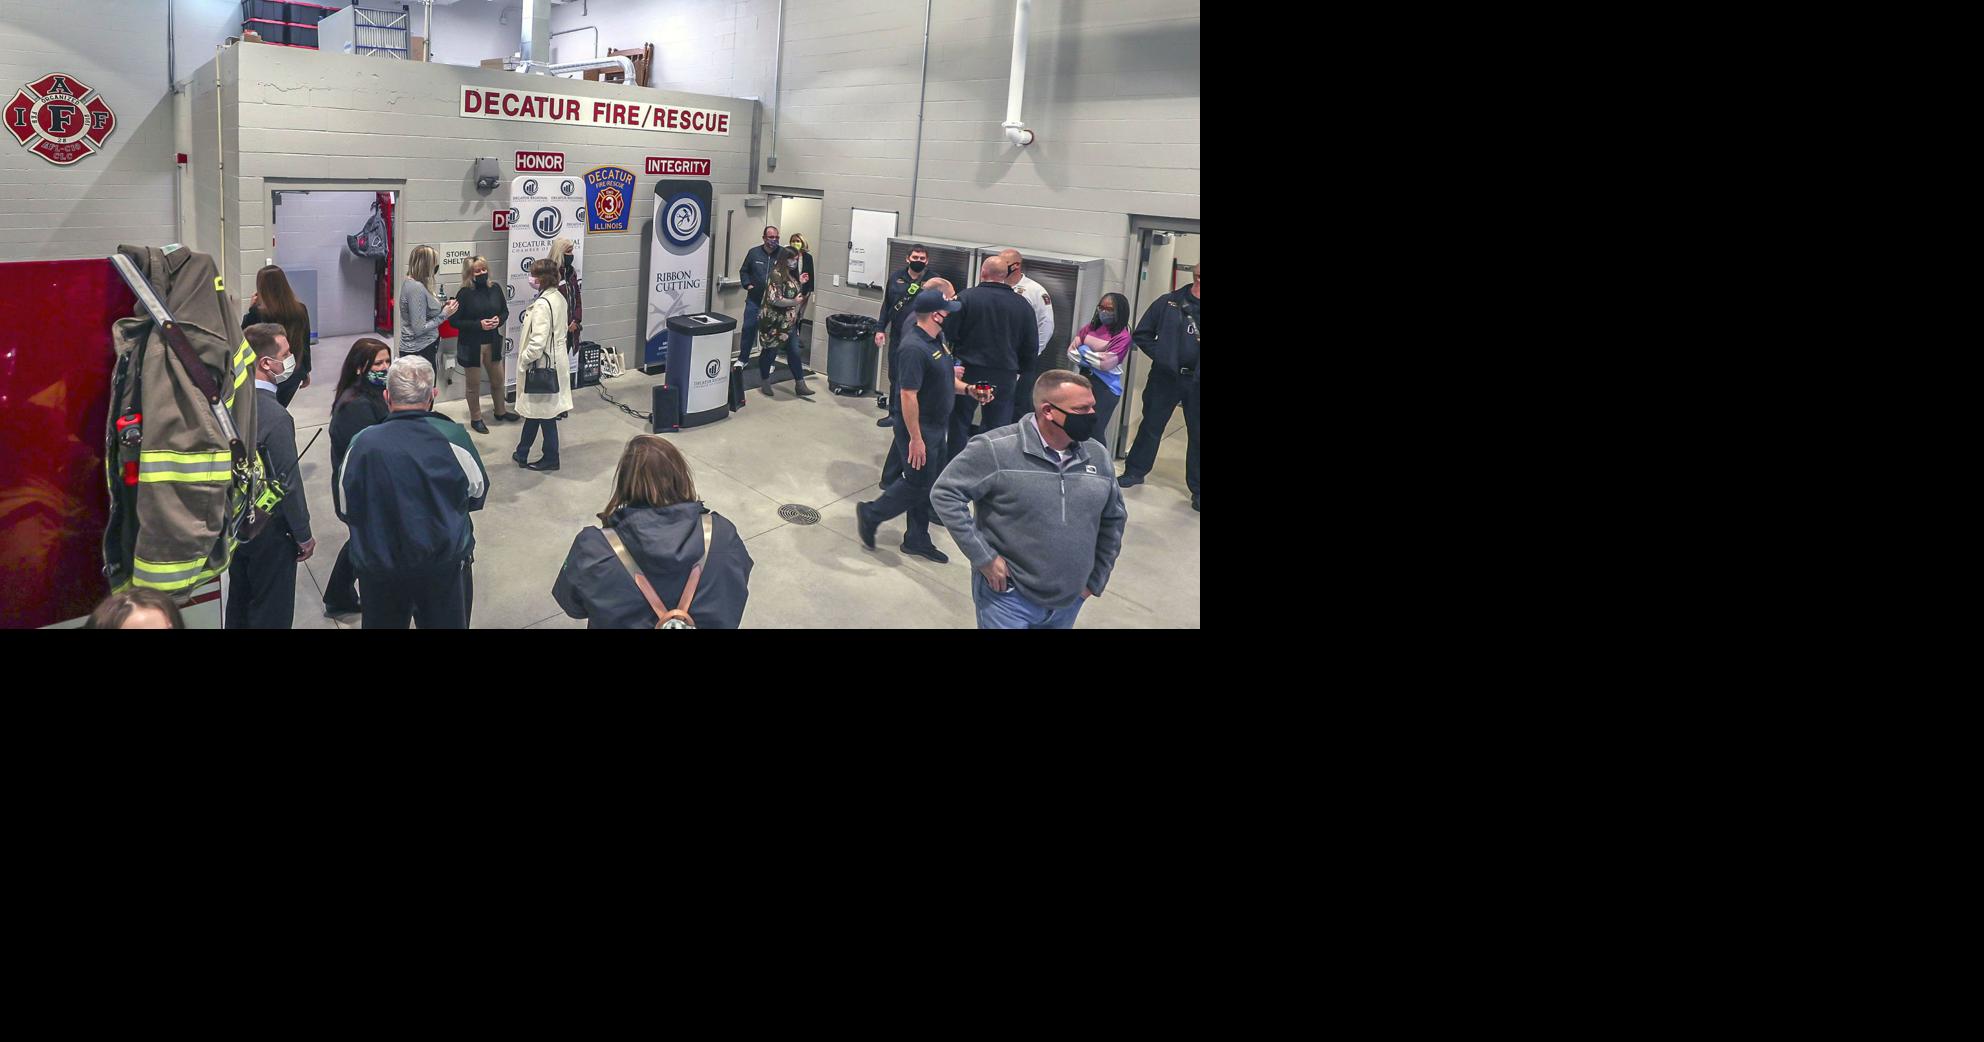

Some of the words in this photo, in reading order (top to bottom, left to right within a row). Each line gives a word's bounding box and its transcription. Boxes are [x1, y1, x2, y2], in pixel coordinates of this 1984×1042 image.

[47, 77, 73, 94] A
[41, 94, 80, 106] ORGANIZED
[464, 89, 580, 121] DECATUR
[593, 102, 729, 133] FIRE/RESCUE
[48, 105, 75, 133] F
[92, 112, 108, 129] F
[516, 153, 562, 170] HONOR
[648, 159, 708, 173] INTEGRITY
[588, 170, 633, 184] DECATUR
[604, 196, 614, 213] 3
[512, 240, 546, 249] DECATUR
[443, 257, 464, 265] SHELT
[656, 271, 691, 282] RIBBON
[655, 279, 700, 292] CUTTING
